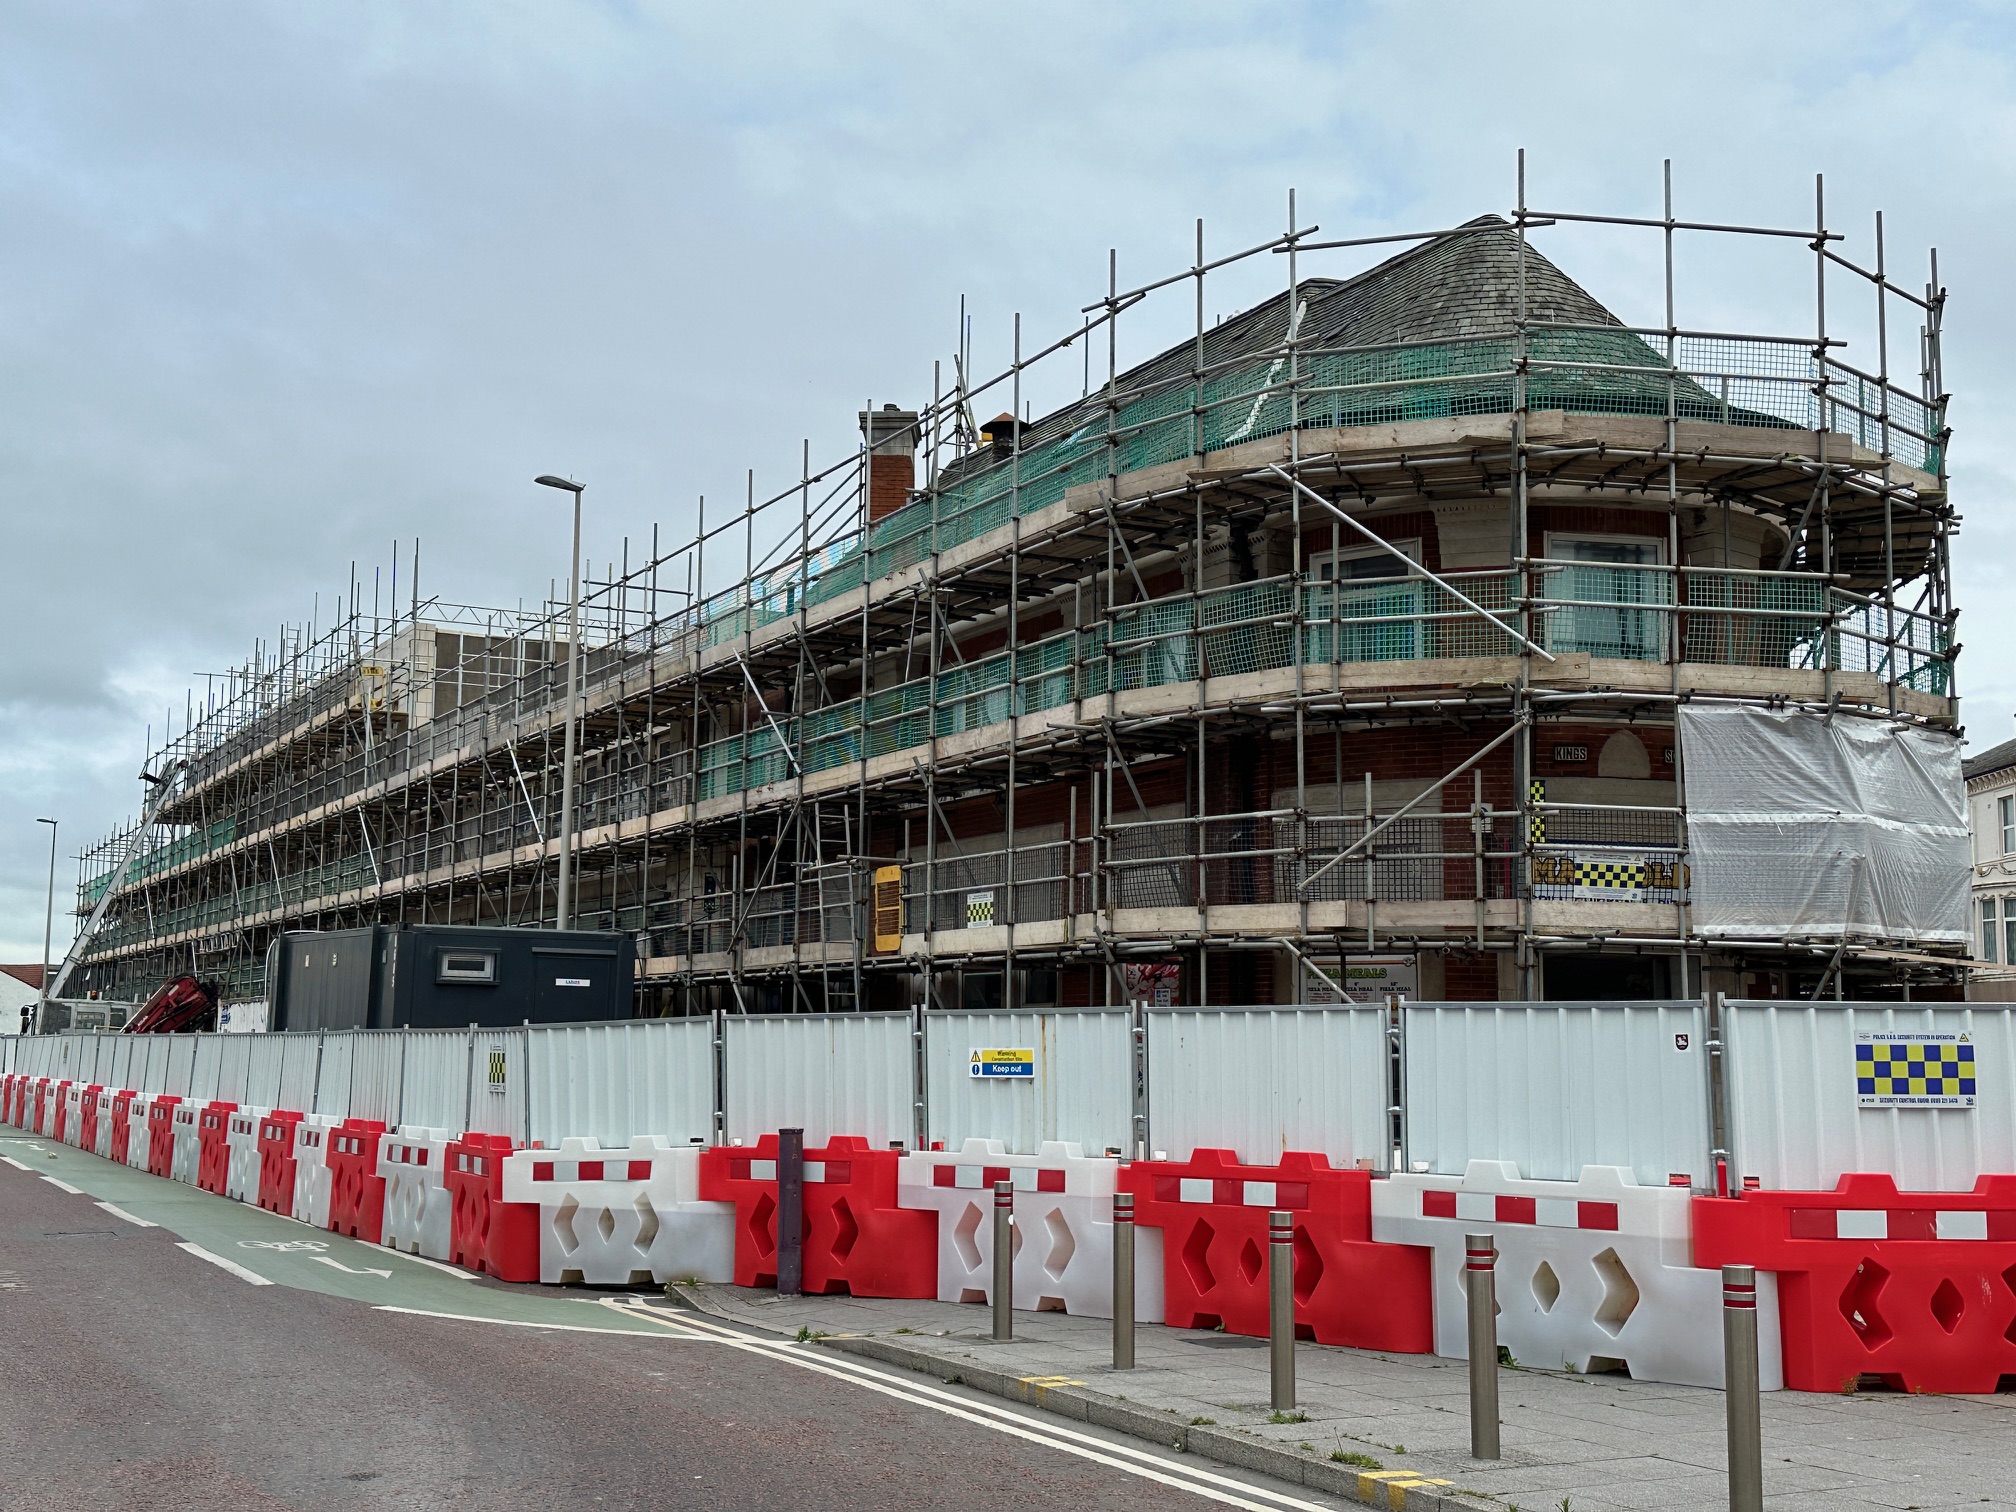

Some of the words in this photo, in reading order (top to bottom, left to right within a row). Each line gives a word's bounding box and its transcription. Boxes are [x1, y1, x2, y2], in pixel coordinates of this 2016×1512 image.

[1555, 746, 1588, 761] KINGS
[1345, 968, 1388, 979] MEALS
[992, 1064, 1009, 1073] Keep
